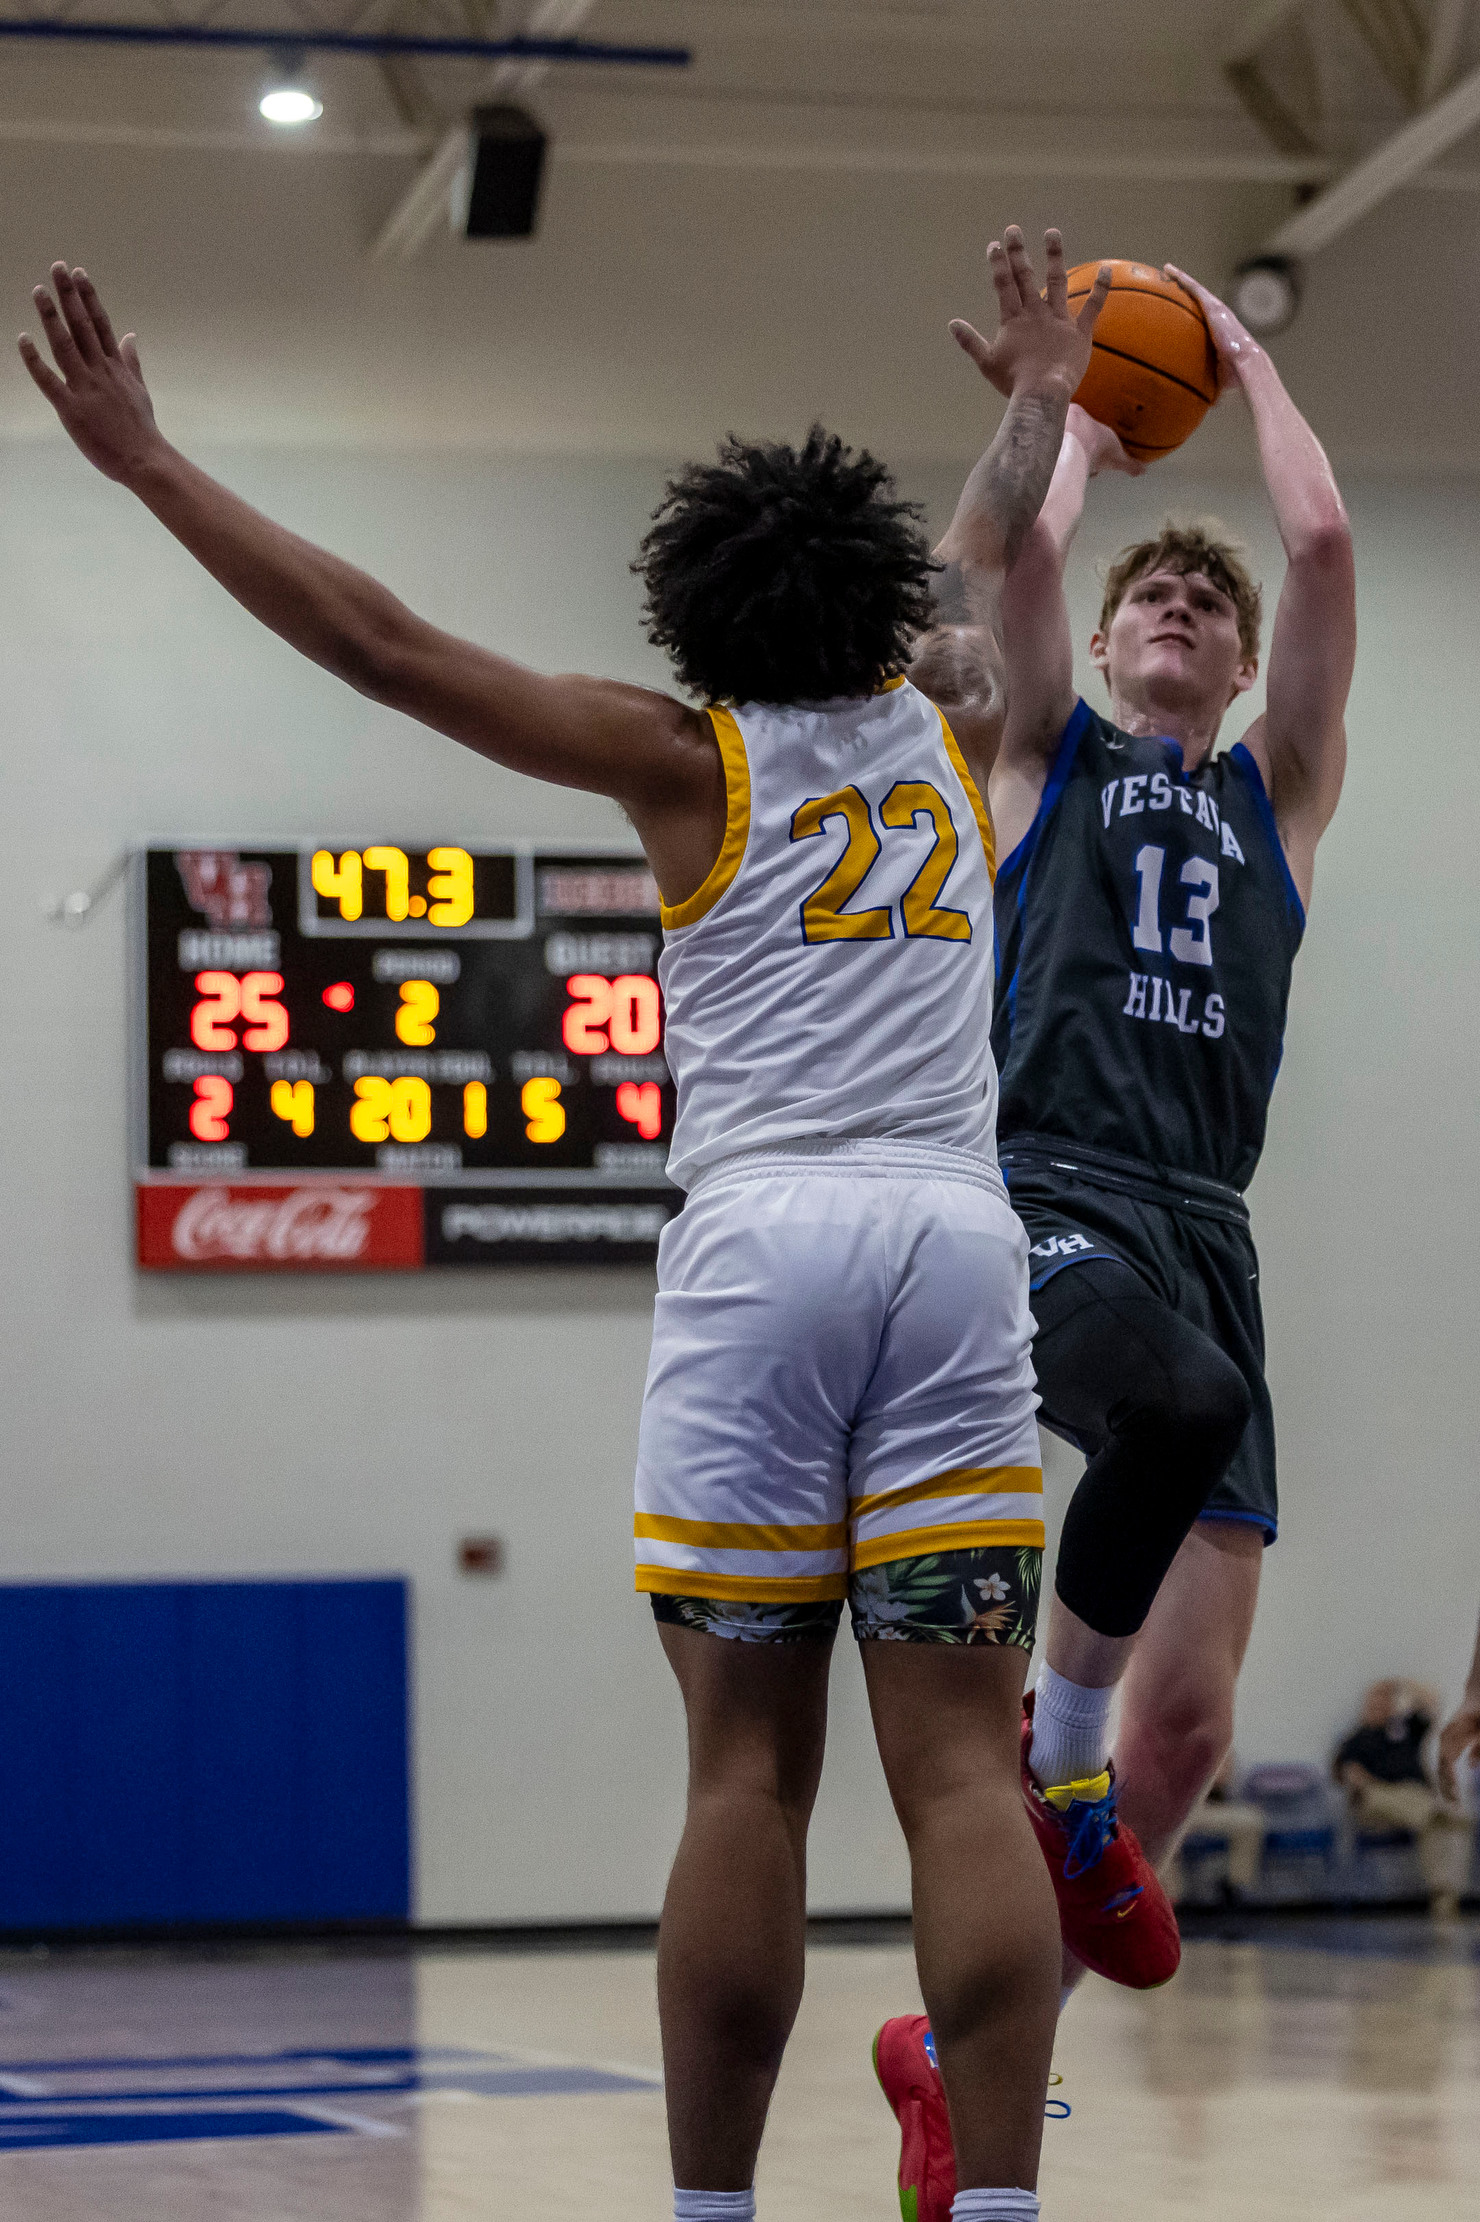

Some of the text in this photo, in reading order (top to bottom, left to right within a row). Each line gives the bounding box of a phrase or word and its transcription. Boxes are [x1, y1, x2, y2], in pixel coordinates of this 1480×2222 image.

[1101, 772, 1246, 866] VESTAVA
[312, 846, 474, 927] 47.3
[789, 779, 973, 946] 22
[1134, 845, 1220, 966] 13
[191, 971, 289, 1052] 25
[395, 980, 439, 1046] 2
[563, 974, 660, 1055] 20
[1123, 972, 1226, 1038] HILLS
[189, 1075, 234, 1142] 2
[270, 1079, 315, 1138] 4
[350, 1076, 432, 1143] 20
[463, 1080, 488, 1139] 1
[521, 1077, 566, 1143] 5
[616, 1081, 662, 1140] 4
[1030, 1233, 1094, 1257] VH
